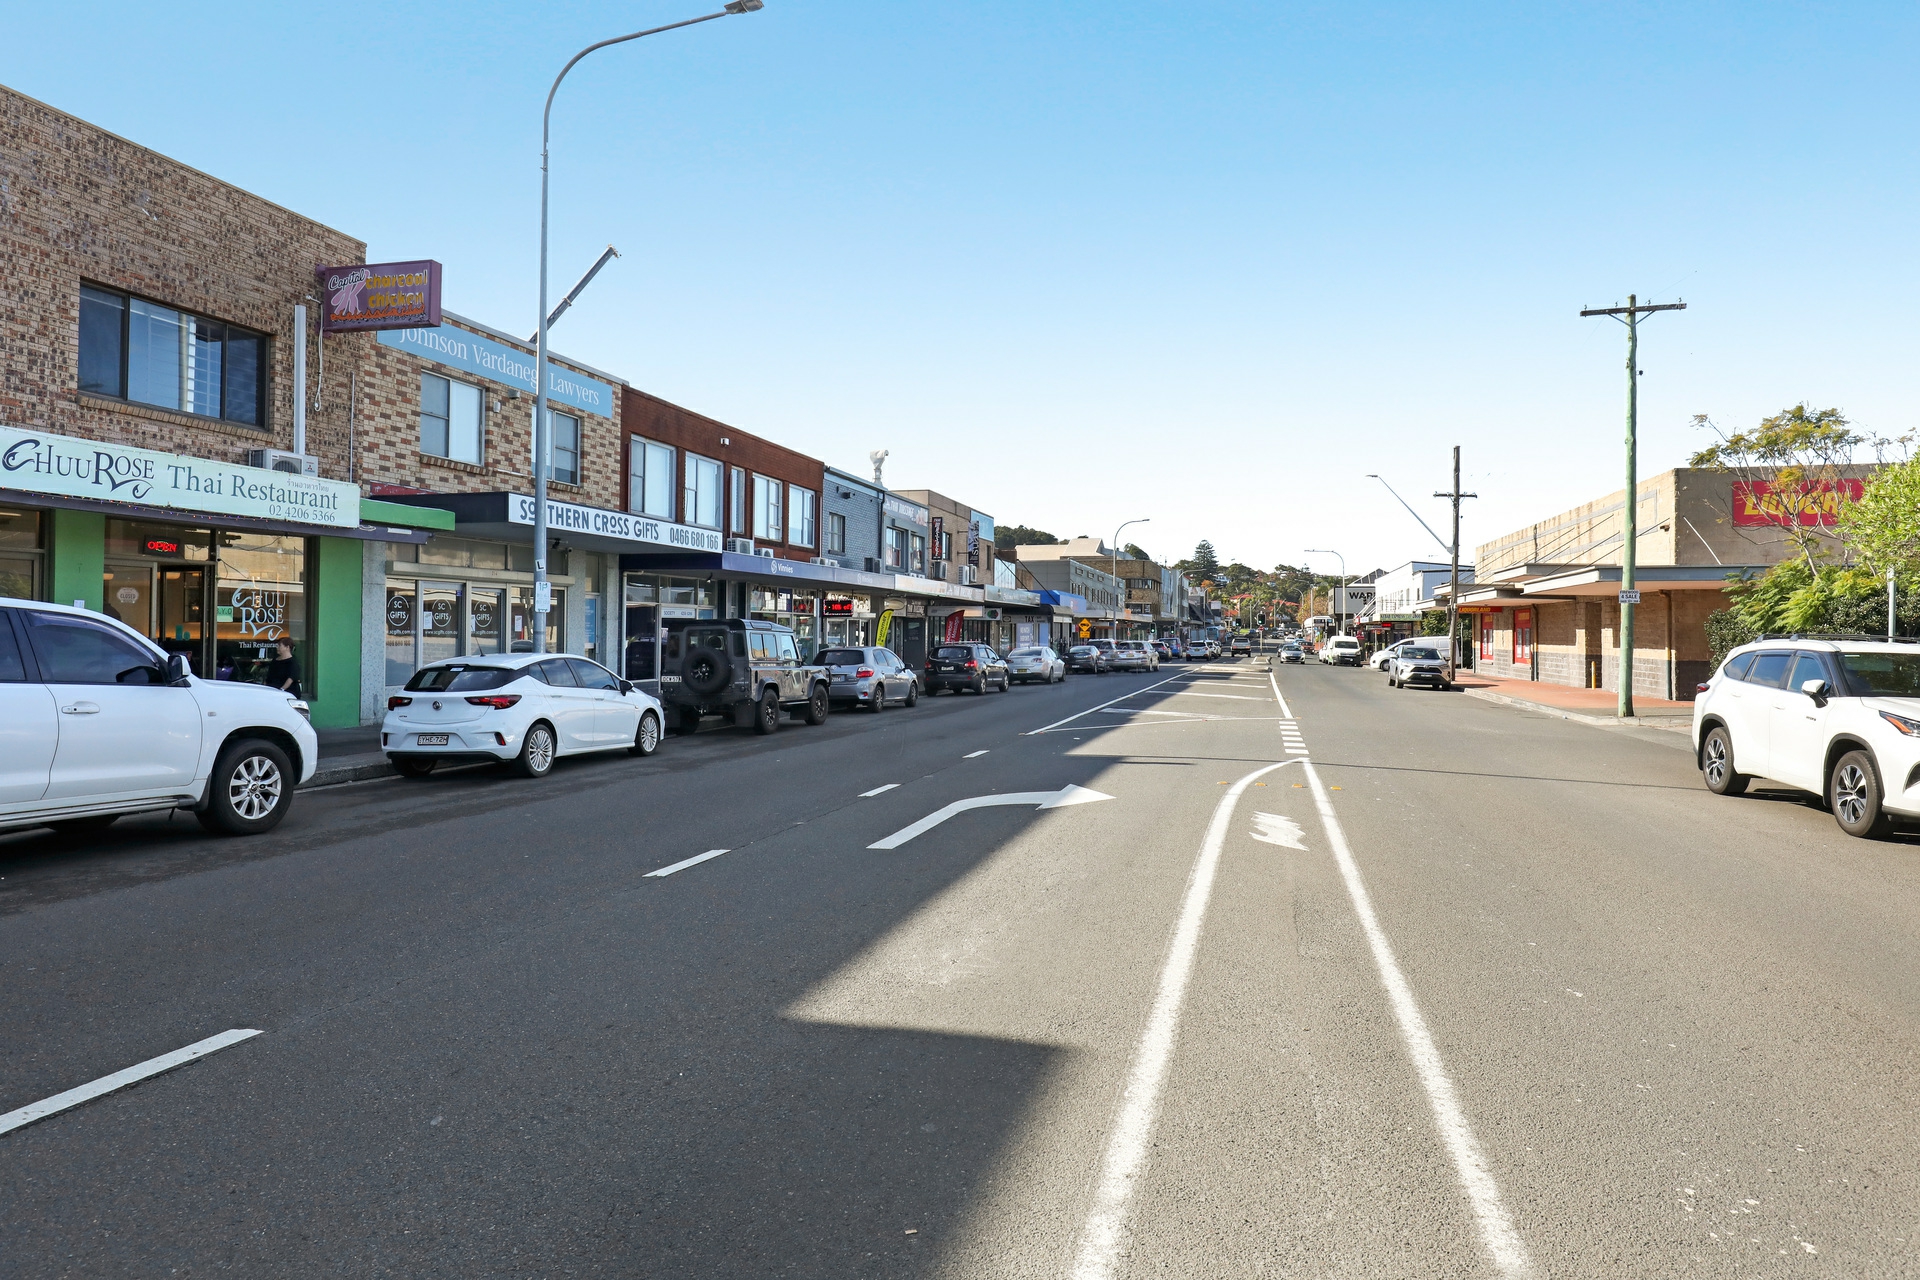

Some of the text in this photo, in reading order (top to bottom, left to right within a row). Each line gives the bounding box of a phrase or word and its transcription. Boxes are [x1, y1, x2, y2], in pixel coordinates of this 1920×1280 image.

[328, 268, 365, 290] Capital
[365, 269, 428, 289] charcoal
[368, 291, 425, 308] chicken
[400, 328, 600, 405] Johnson Vardaneg Lawyers
[167, 464, 338, 510] Thai Restaurant
[268, 504, 335, 522] 02 4206 5366
[520, 499, 659, 541] SOTHERN CROSS GIFTS
[147, 541, 178, 552] OPEN
[669, 527, 719, 550] 0466 680 166
[778, 563, 794, 574] Vinnies
[240, 606, 284, 641] ROSE
[390, 611, 406, 619] GIFTS
[239, 641, 279, 649] Thai Restauran
